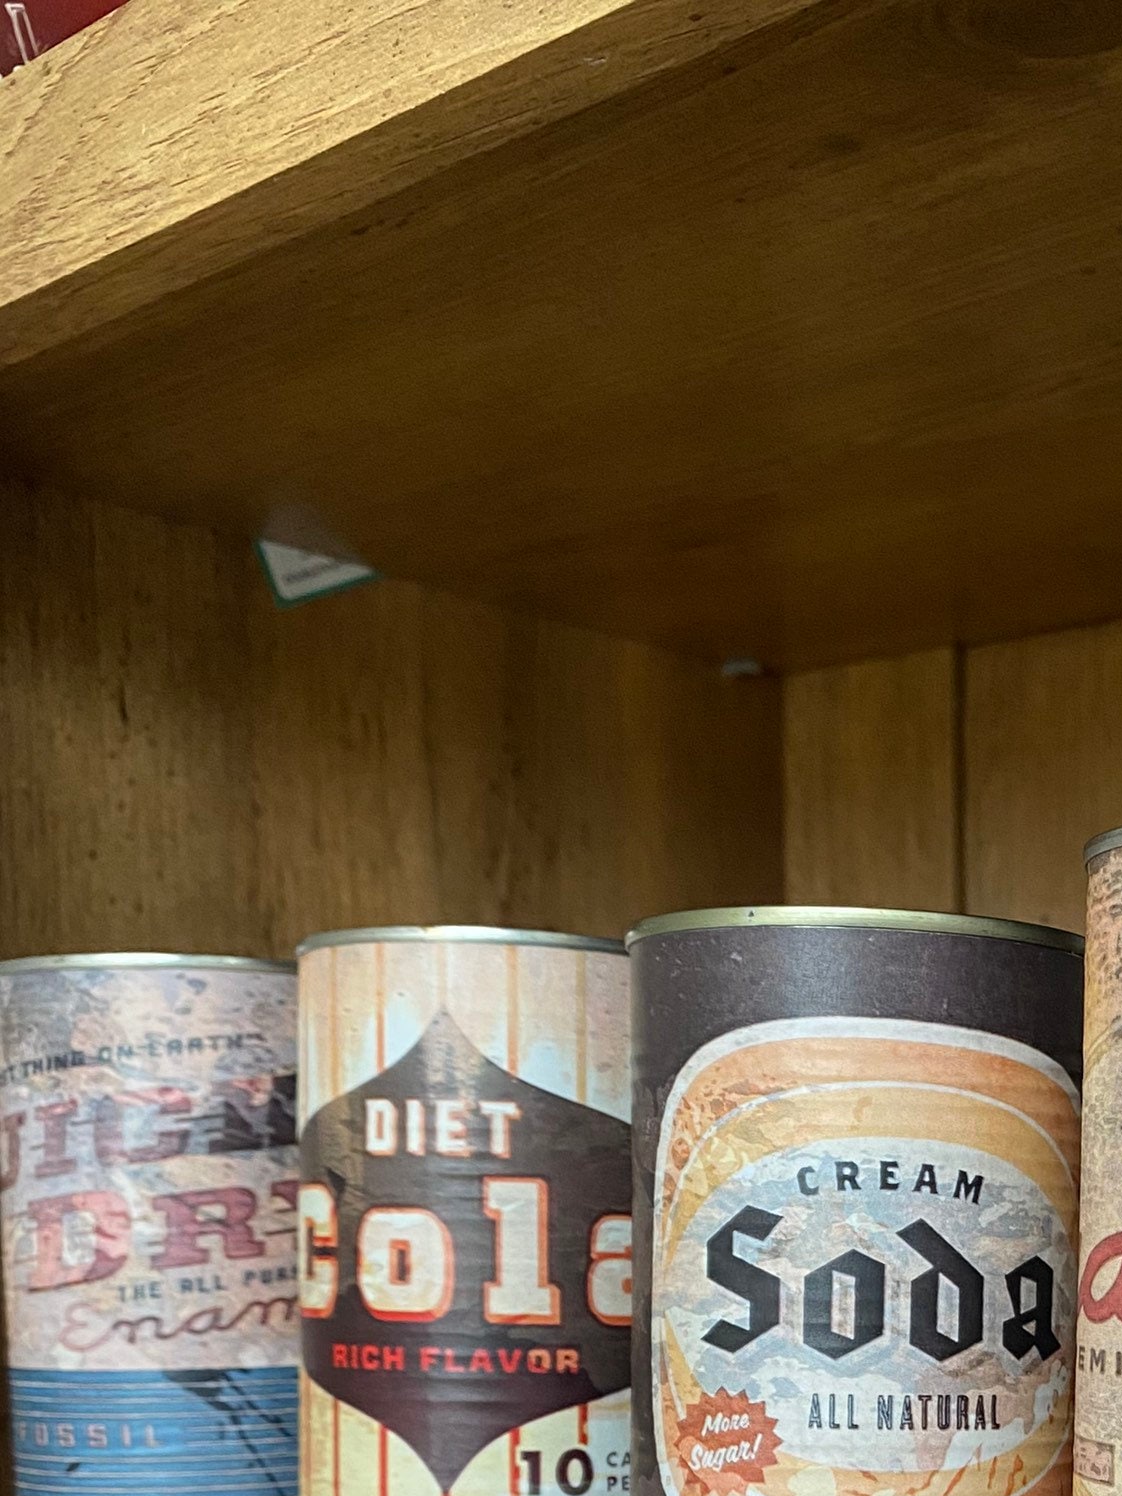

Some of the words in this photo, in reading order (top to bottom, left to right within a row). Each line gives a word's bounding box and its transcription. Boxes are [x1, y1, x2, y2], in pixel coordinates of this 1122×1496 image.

[364, 1097, 523, 1158] DIET
[798, 1160, 985, 1205] CREAM
[118, 1281, 162, 1302] THE
[701, 1205, 1062, 1363] Soda
[332, 1342, 405, 1373] RICH
[418, 1346, 580, 1375] FLAVOR
[701, 1411, 750, 1437] More
[808, 1393, 860, 1430] ALL
[876, 1394, 1001, 1431] NATURAL
[520, 1448, 595, 1496] 10
[690, 1432, 764, 1473] Sugar!
